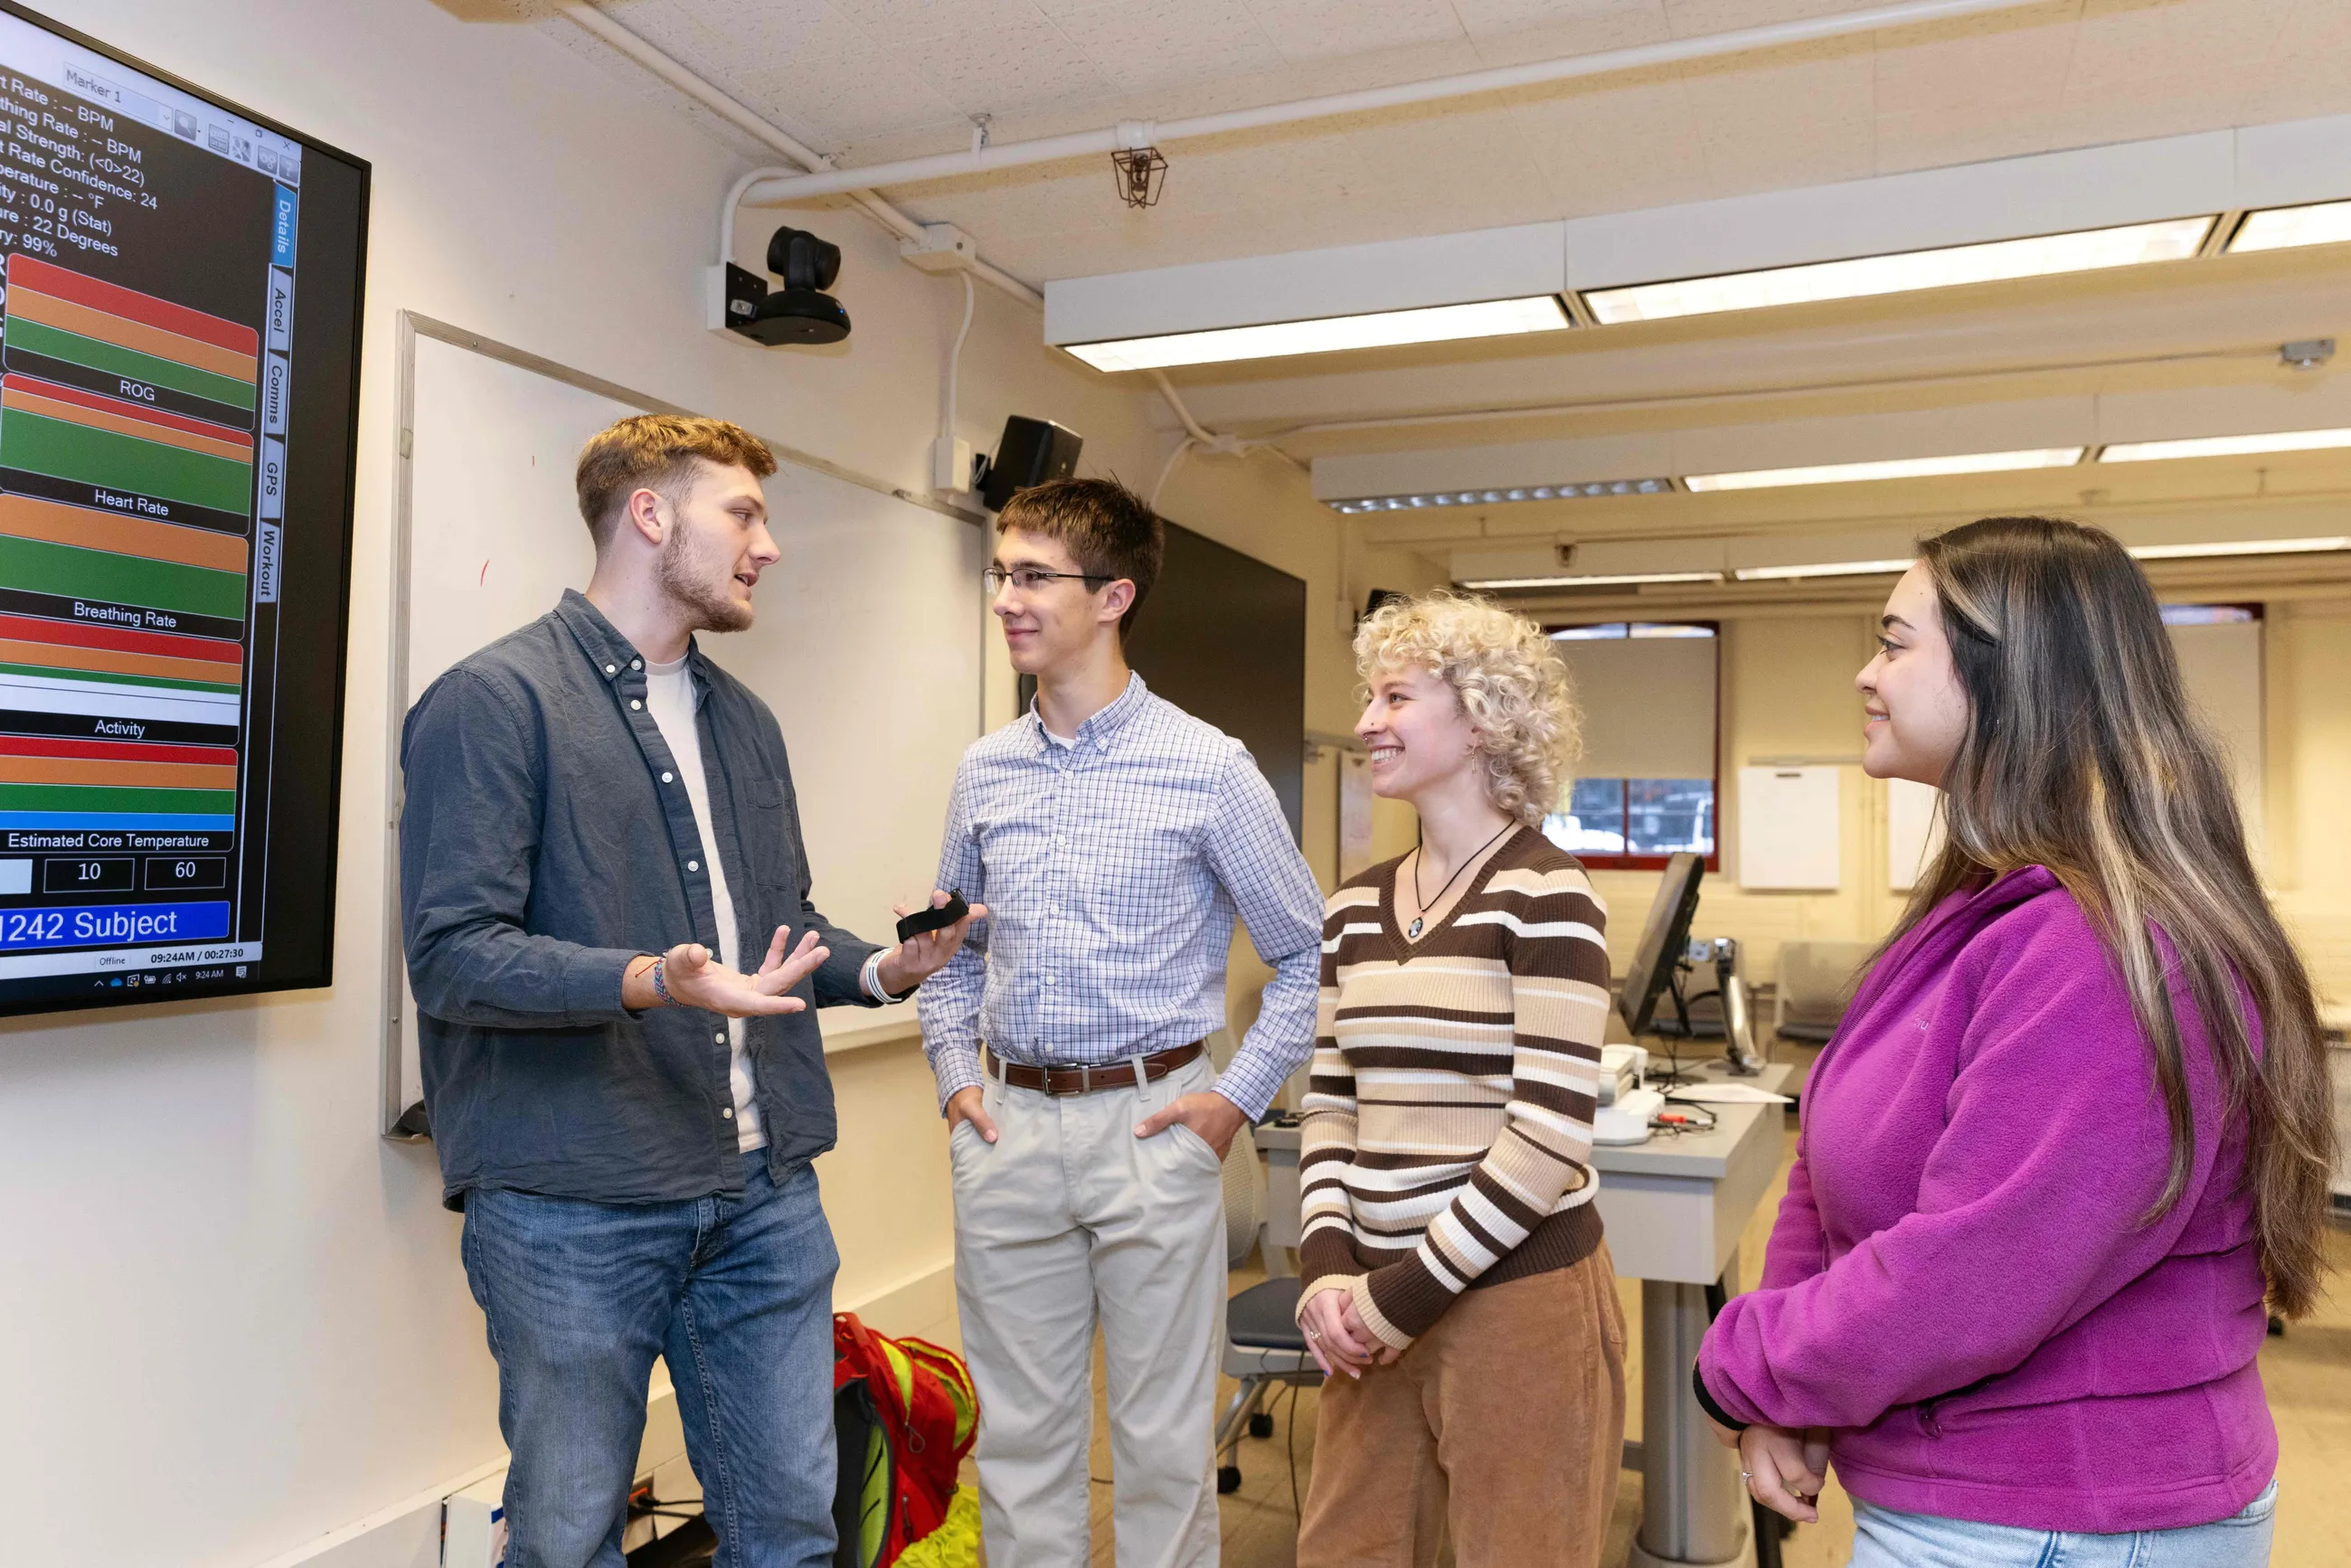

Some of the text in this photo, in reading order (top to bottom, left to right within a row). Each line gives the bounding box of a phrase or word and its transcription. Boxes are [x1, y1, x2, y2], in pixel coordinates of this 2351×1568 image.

[66, 69, 121, 103] Marker 1
[11, 78, 49, 105] Rate
[78, 105, 114, 133] BPM
[42, 112, 79, 139] Rate
[107, 137, 142, 165] BPM
[16, 123, 85, 163] Strength:
[90, 152, 145, 188] (<0>22)
[8, 141, 46, 169] Rate
[50, 158, 137, 203] Confidence:
[140, 192, 158, 210] 24
[30, 194, 54, 214] 0.0
[58, 207, 69, 222] g
[72, 209, 112, 237] (Stat)
[89, 192, 105, 209] °F
[33, 216, 52, 235] 22
[57, 223, 118, 257] Degrees
[277, 199, 291, 254] Details
[23, 233, 58, 258] 99%
[273, 288, 287, 334] Accel
[119, 380, 156, 401] ROG
[269, 364, 283, 424] Comms
[266, 462, 279, 496] GPS
[94, 489, 169, 516] Heart Rate
[260, 530, 276, 596] Workout
[74, 601, 177, 628] Breathing Rate
[94, 720, 146, 739] Activity
[7, 833, 210, 850] Estimated Core Temperature
[77, 863, 101, 881] 10
[175, 862, 196, 879] 60
[73, 911, 177, 942] Subject
[99, 956, 127, 966] Offline
[150, 953, 195, 964] 09:24AM
[204, 948, 244, 959] 00:27:30
[195, 969, 224, 980] 9:24 AM
